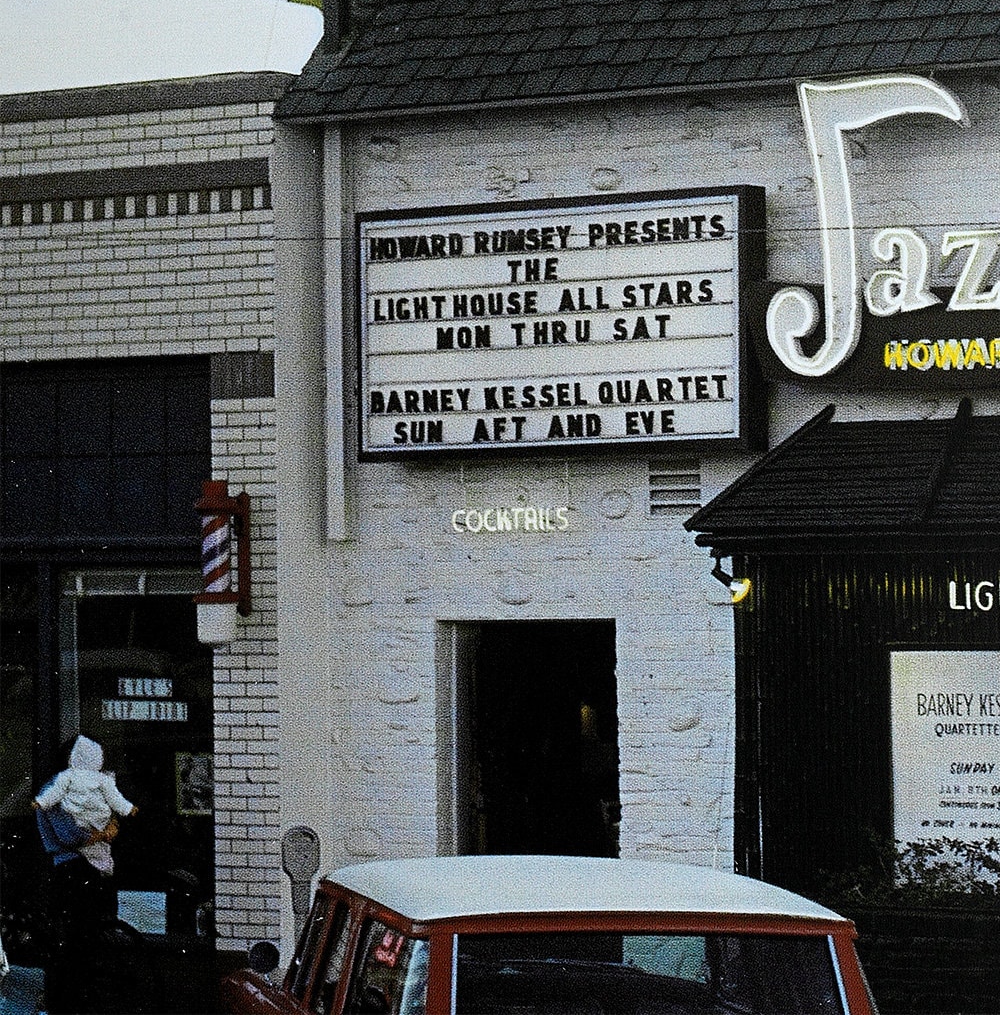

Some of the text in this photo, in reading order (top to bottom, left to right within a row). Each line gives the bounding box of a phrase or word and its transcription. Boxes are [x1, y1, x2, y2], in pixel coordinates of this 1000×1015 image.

[370, 214, 726, 261] HOWARD RUMSEY PRESENTS
[507, 258, 559, 283] THE
[373, 280, 714, 323] LIGHTHOUSE ALL STARS
[436, 314, 672, 351] MON THRU SAT
[370, 374, 728, 415] BARNEY KESSEL QUARTET
[394, 410, 676, 445] SUN AFT AND EVE
[451, 506, 570, 534] COCKTAILS
[917, 693, 974, 717] BARNEY
[934, 723, 1000, 737] QUARTETTE
[950, 762, 995, 775] SUNDAY
